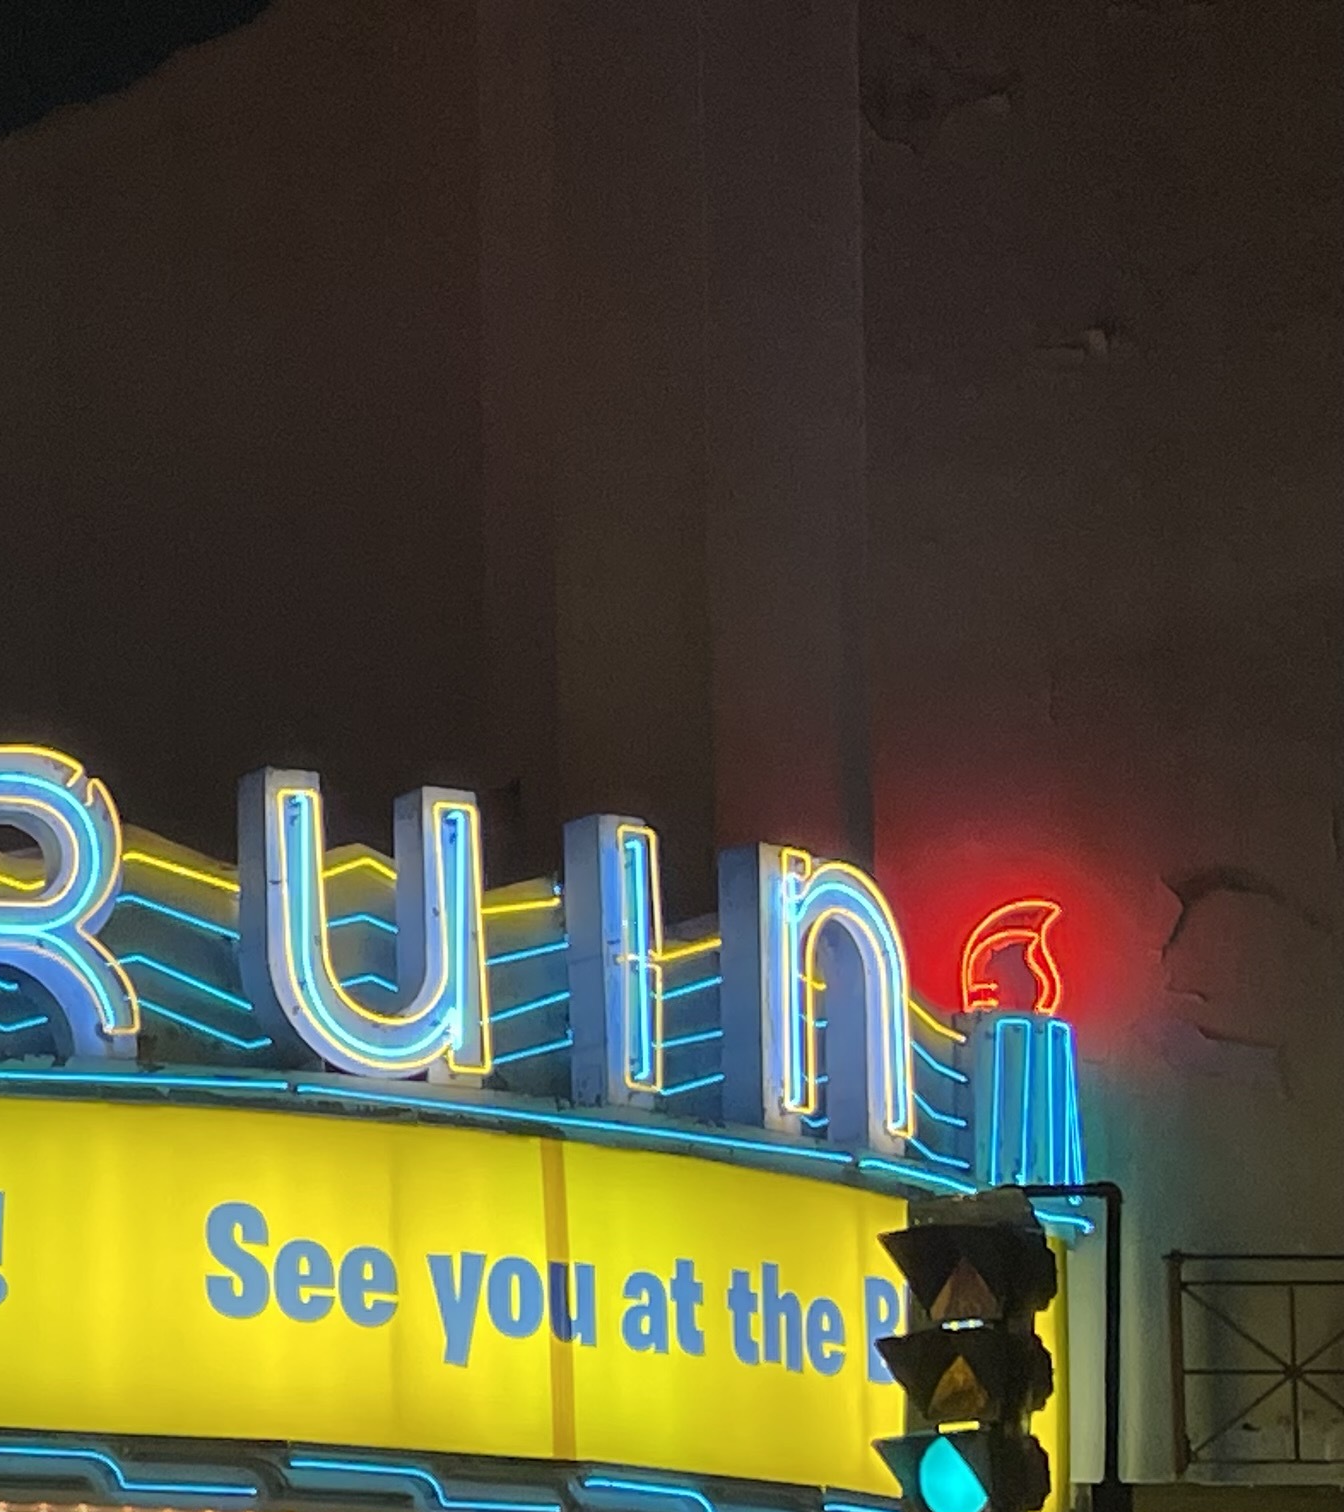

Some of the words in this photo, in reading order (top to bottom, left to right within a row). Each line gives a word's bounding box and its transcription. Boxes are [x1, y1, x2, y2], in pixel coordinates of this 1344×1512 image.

[205, 1201, 398, 1327] See
[427, 1251, 597, 1367] you
[621, 1258, 706, 1356] at
[726, 1262, 846, 1376] the
